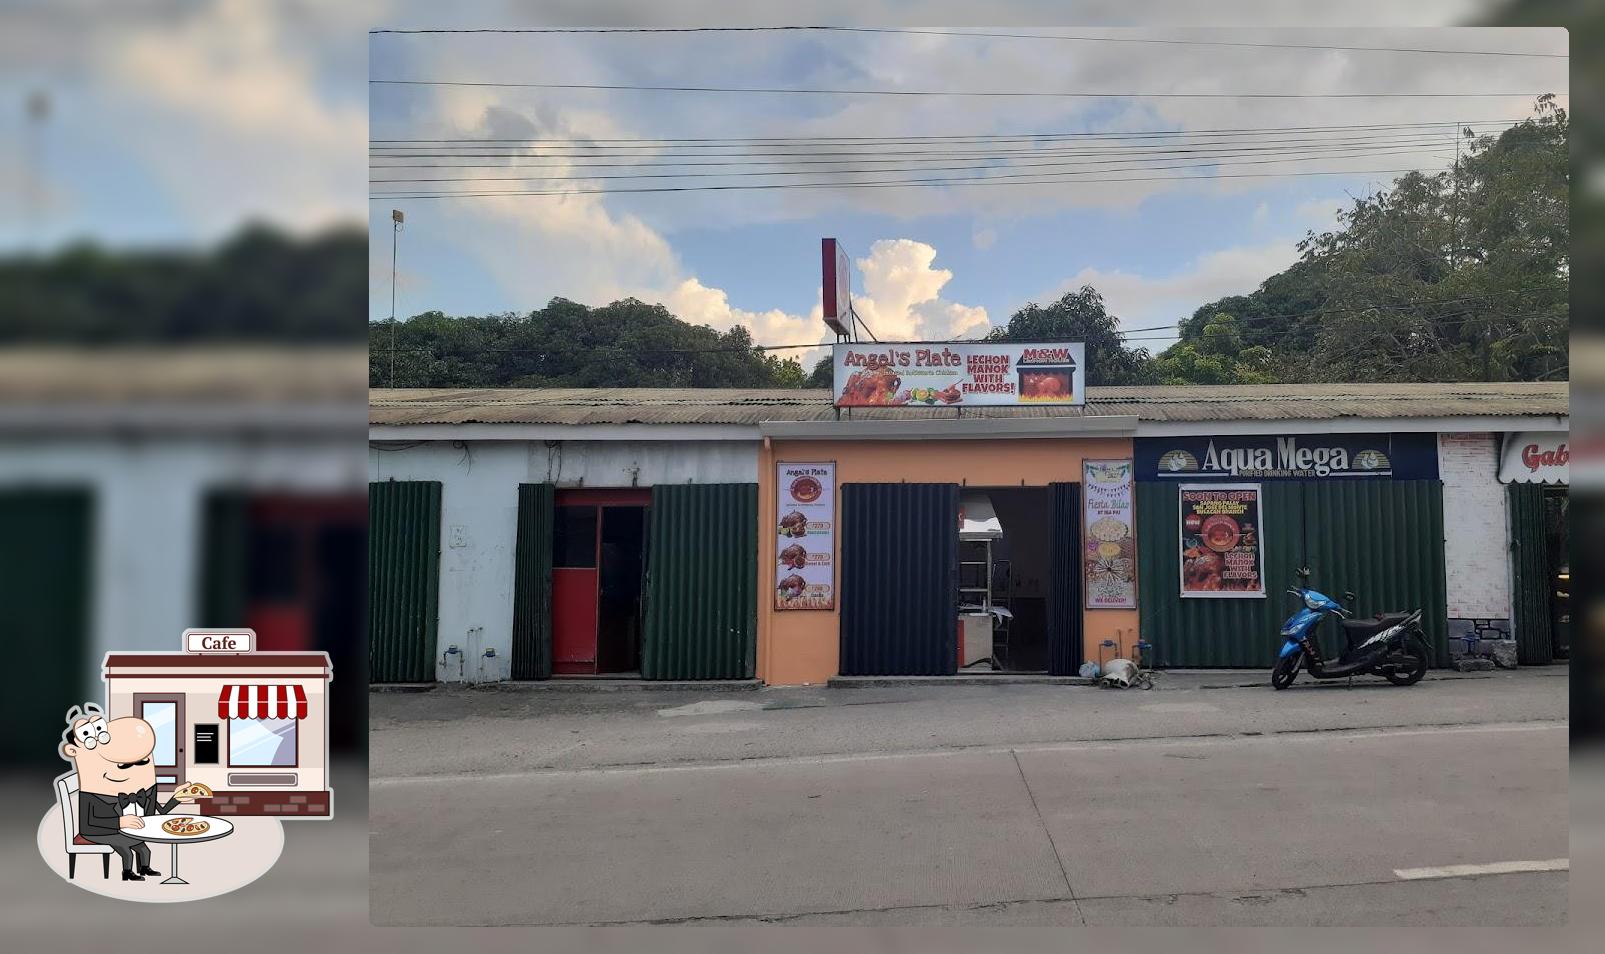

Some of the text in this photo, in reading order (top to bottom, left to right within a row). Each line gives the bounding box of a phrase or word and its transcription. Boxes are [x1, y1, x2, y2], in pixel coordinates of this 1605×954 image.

[844, 348, 962, 370] Angel's Plate
[967, 355, 1009, 364] LECHON
[967, 364, 1009, 374] MANOK
[973, 373, 1003, 383] WITH
[962, 383, 1015, 393] FLAVORS!
[1202, 438, 1350, 476] Aqua Mega
[1183, 492, 1257, 501] SOON TO OPEN
[1223, 571, 1258, 579] FLAVORS
